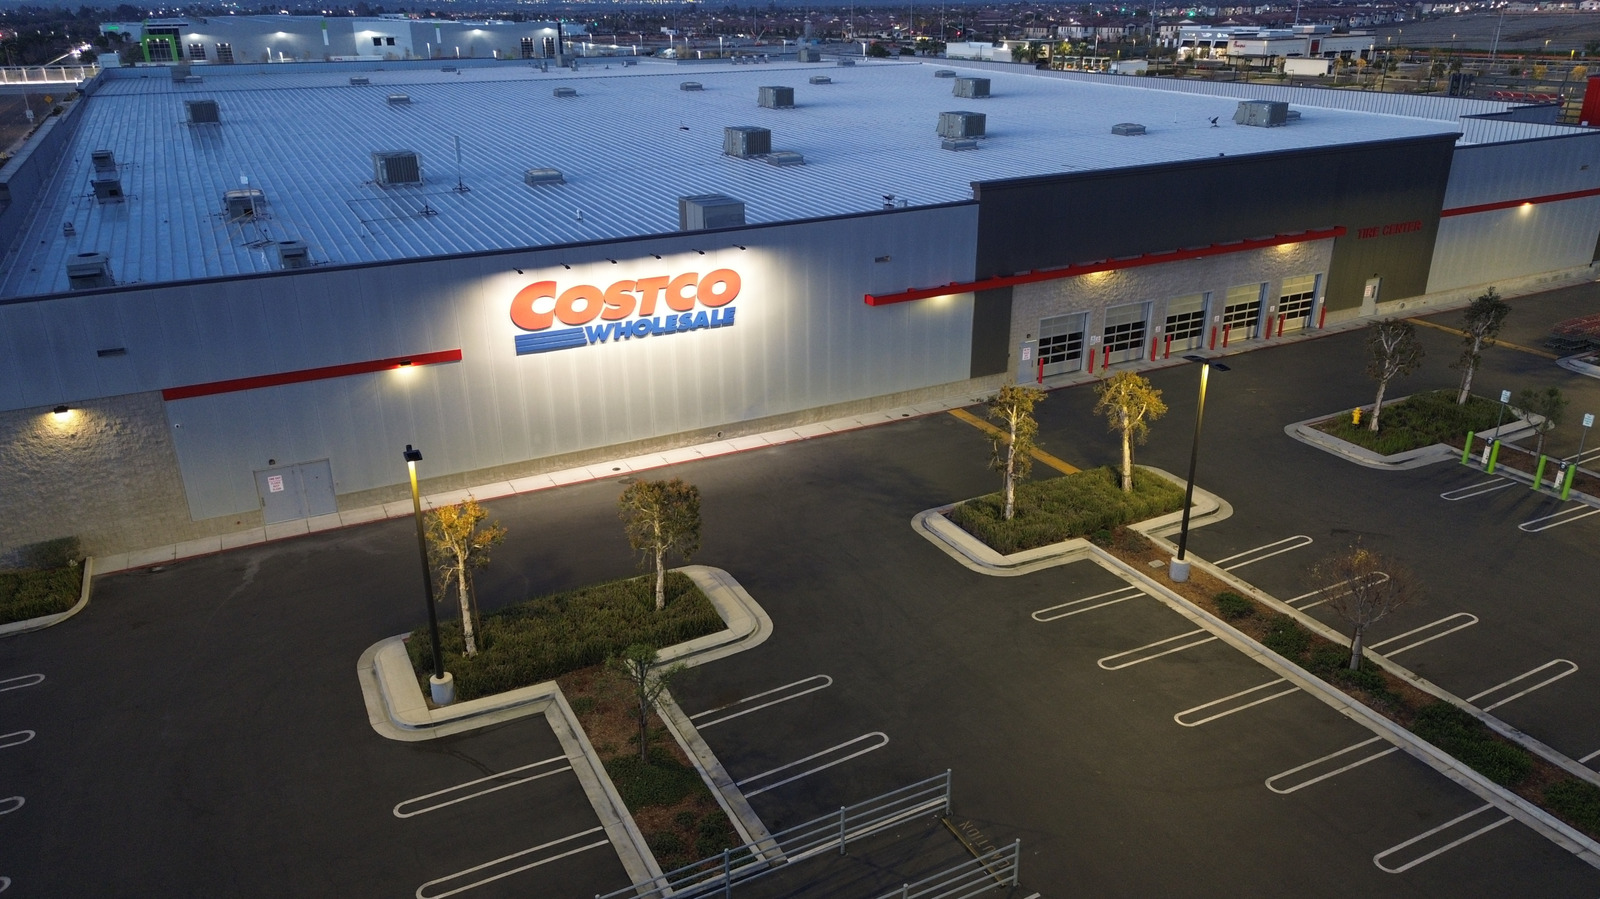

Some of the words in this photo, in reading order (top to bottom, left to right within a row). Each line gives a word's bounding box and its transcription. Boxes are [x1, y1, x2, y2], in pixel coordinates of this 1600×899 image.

[1357, 227, 1380, 239] TIRE
[1382, 221, 1422, 236] CENTER
[510, 268, 742, 331] COSTCO
[584, 306, 736, 344] WHOLESALE
